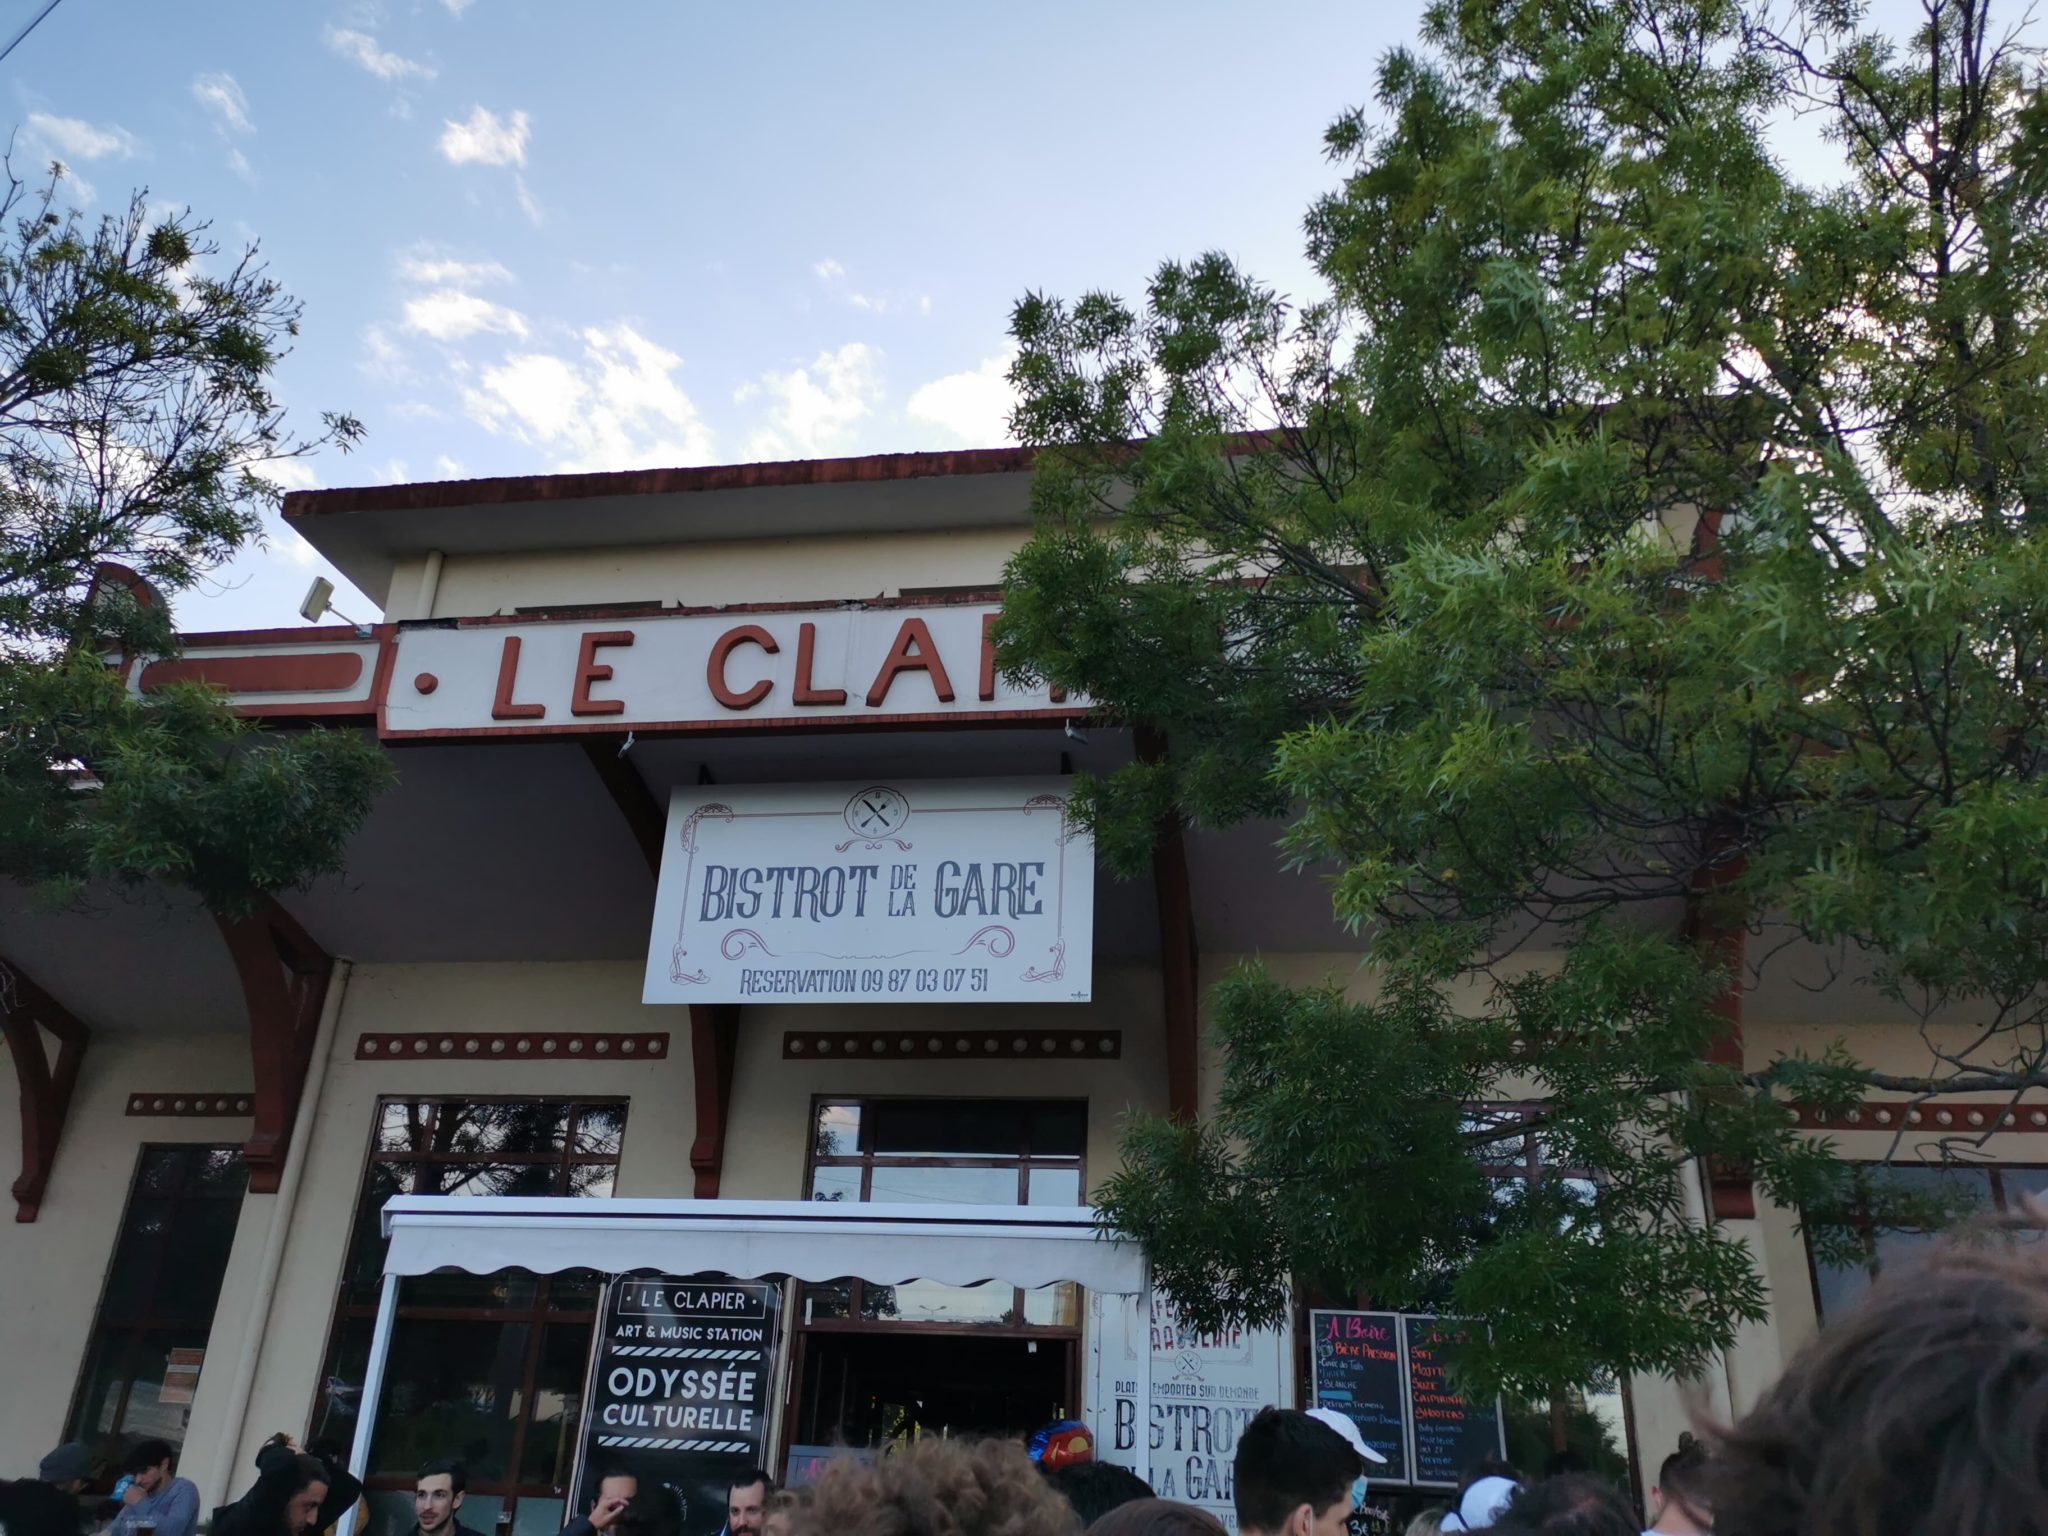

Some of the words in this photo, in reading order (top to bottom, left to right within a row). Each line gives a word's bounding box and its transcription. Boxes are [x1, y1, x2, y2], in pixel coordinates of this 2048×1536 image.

[491, 630, 635, 720] LE
[890, 864, 917, 890] DE
[934, 861, 1045, 921] GARE
[699, 864, 879, 923] BISTROT
[888, 891, 916, 917] LA
[739, 968, 856, 996] RESERVATION
[861, 968, 882, 993] 09
[888, 968, 911, 993] 87
[915, 968, 939, 992] 03
[944, 968, 966, 992] 07
[970, 968, 988, 992] 51
[641, 1290, 664, 1307] LE
[673, 1291, 745, 1310] CLAPIER
[615, 1325, 643, 1338] ART
[646, 1325, 656, 1338] &
[660, 1326, 702, 1340] MUSIC
[706, 1327, 762, 1342] STATION
[608, 1362, 757, 1401] ODYSSÉE
[1152, 1382, 1197, 1398] EMPORTER
[603, 1403, 753, 1431] CULTURELLE
[1114, 1399, 1258, 1456] BSTROT
